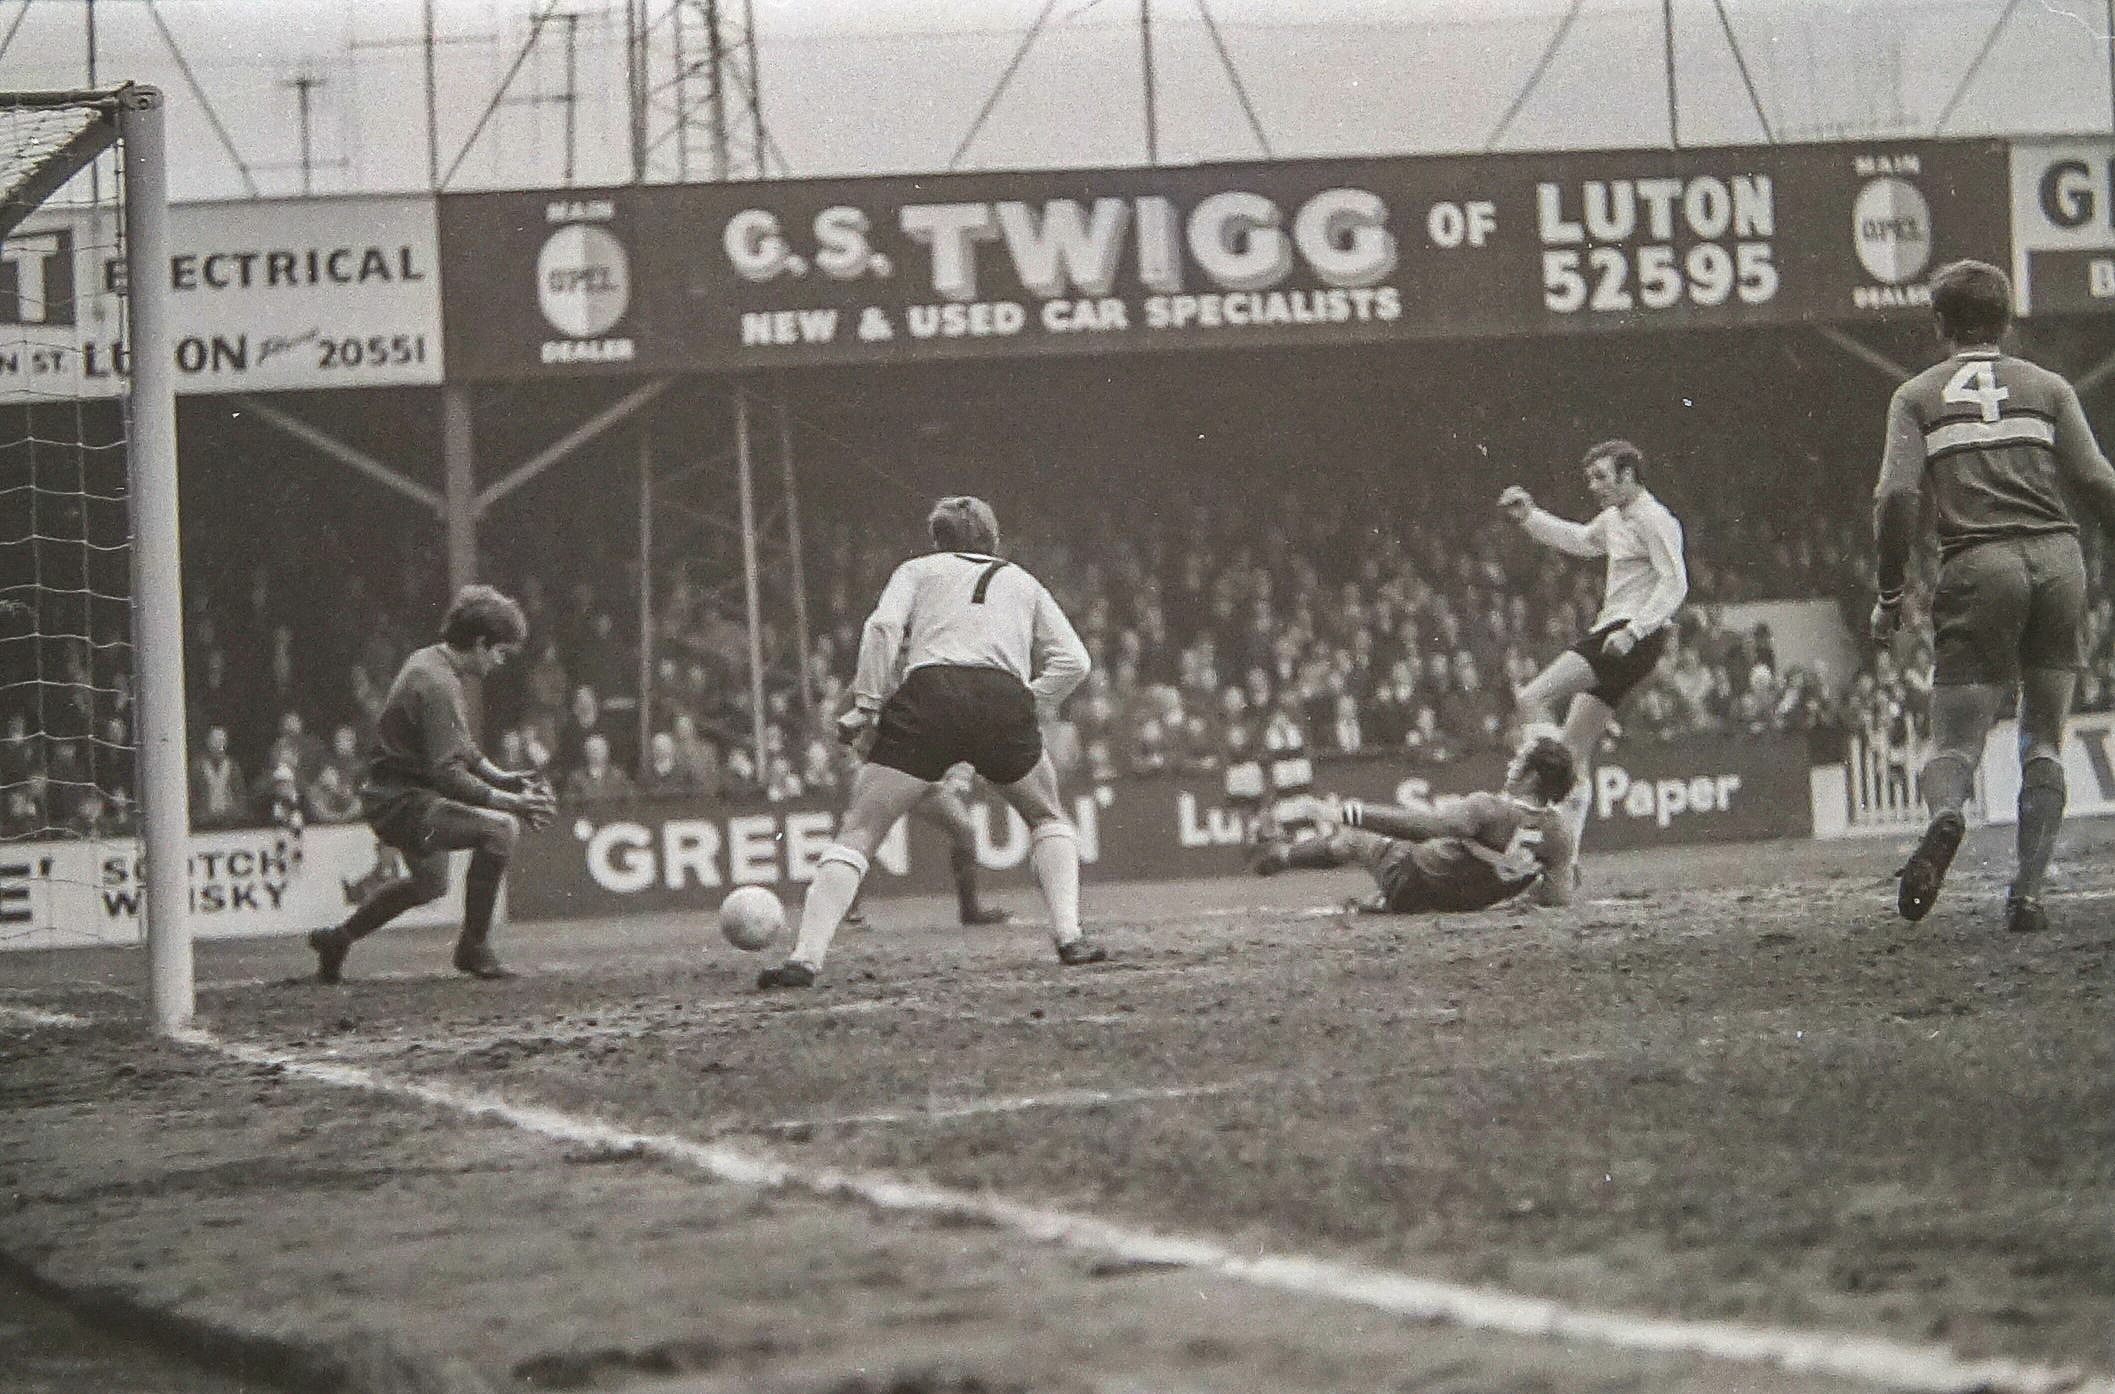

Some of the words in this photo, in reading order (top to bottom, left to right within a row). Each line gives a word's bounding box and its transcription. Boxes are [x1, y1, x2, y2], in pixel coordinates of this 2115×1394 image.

[1537, 176, 1776, 244] LUTON
[2038, 158, 2115, 229] G
[104, 246, 427, 292] EECTRICAL
[900, 188, 1398, 303] TWIGG
[1428, 202, 1497, 248] OF
[1542, 242, 1779, 314] 52595
[741, 309, 838, 345] NEW
[858, 305, 895, 343] &
[907, 301, 1026, 339] USED
[1040, 298, 1130, 333] CAR
[1144, 286, 1402, 329] SPECIALISTS
[83, 332, 249, 379] LUON
[318, 333, 425, 370] 20551
[1942, 360, 2009, 422] 4
[970, 558, 1009, 604] 7
[1598, 765, 1743, 828] Paper
[103, 850, 288, 884] STCH
[103, 881, 286, 917] WISKY
